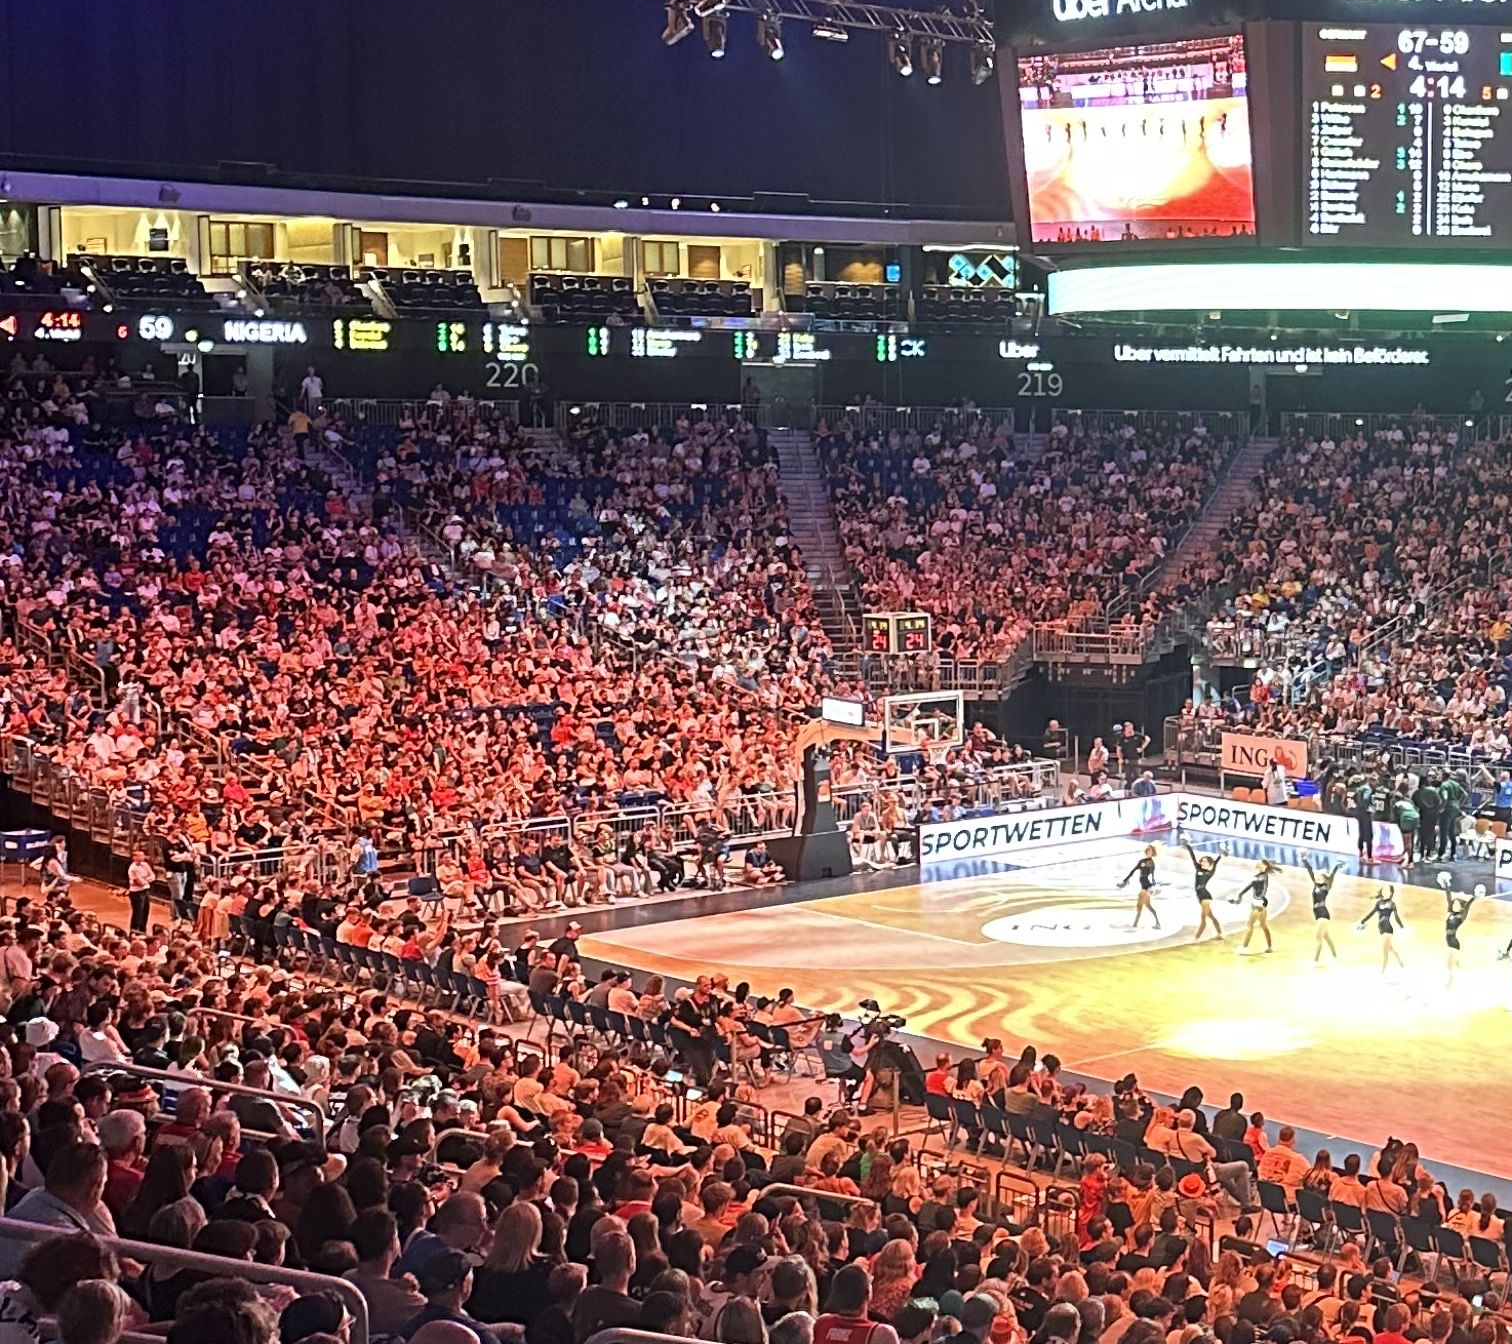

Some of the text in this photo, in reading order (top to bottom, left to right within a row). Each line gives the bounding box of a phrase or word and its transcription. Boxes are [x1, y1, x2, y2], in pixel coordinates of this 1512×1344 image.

[1398, 30, 1469, 54] 67-59
[1370, 84, 1382, 99] 2
[1409, 75, 1467, 98] 4:14
[1481, 86, 1492, 100] 5
[138, 314, 174, 340] 59
[224, 320, 307, 344] NIGERIA
[1000, 341, 1040, 360] Uber
[1114, 345, 1153, 362] Uber
[485, 362, 539, 387] 220
[1018, 372, 1063, 397] 219
[905, 633, 924, 650] 24
[1231, 744, 1268, 768] ING
[921, 811, 1103, 856] SPORTWETTEN
[1177, 802, 1331, 843] SPORTWETTEN
